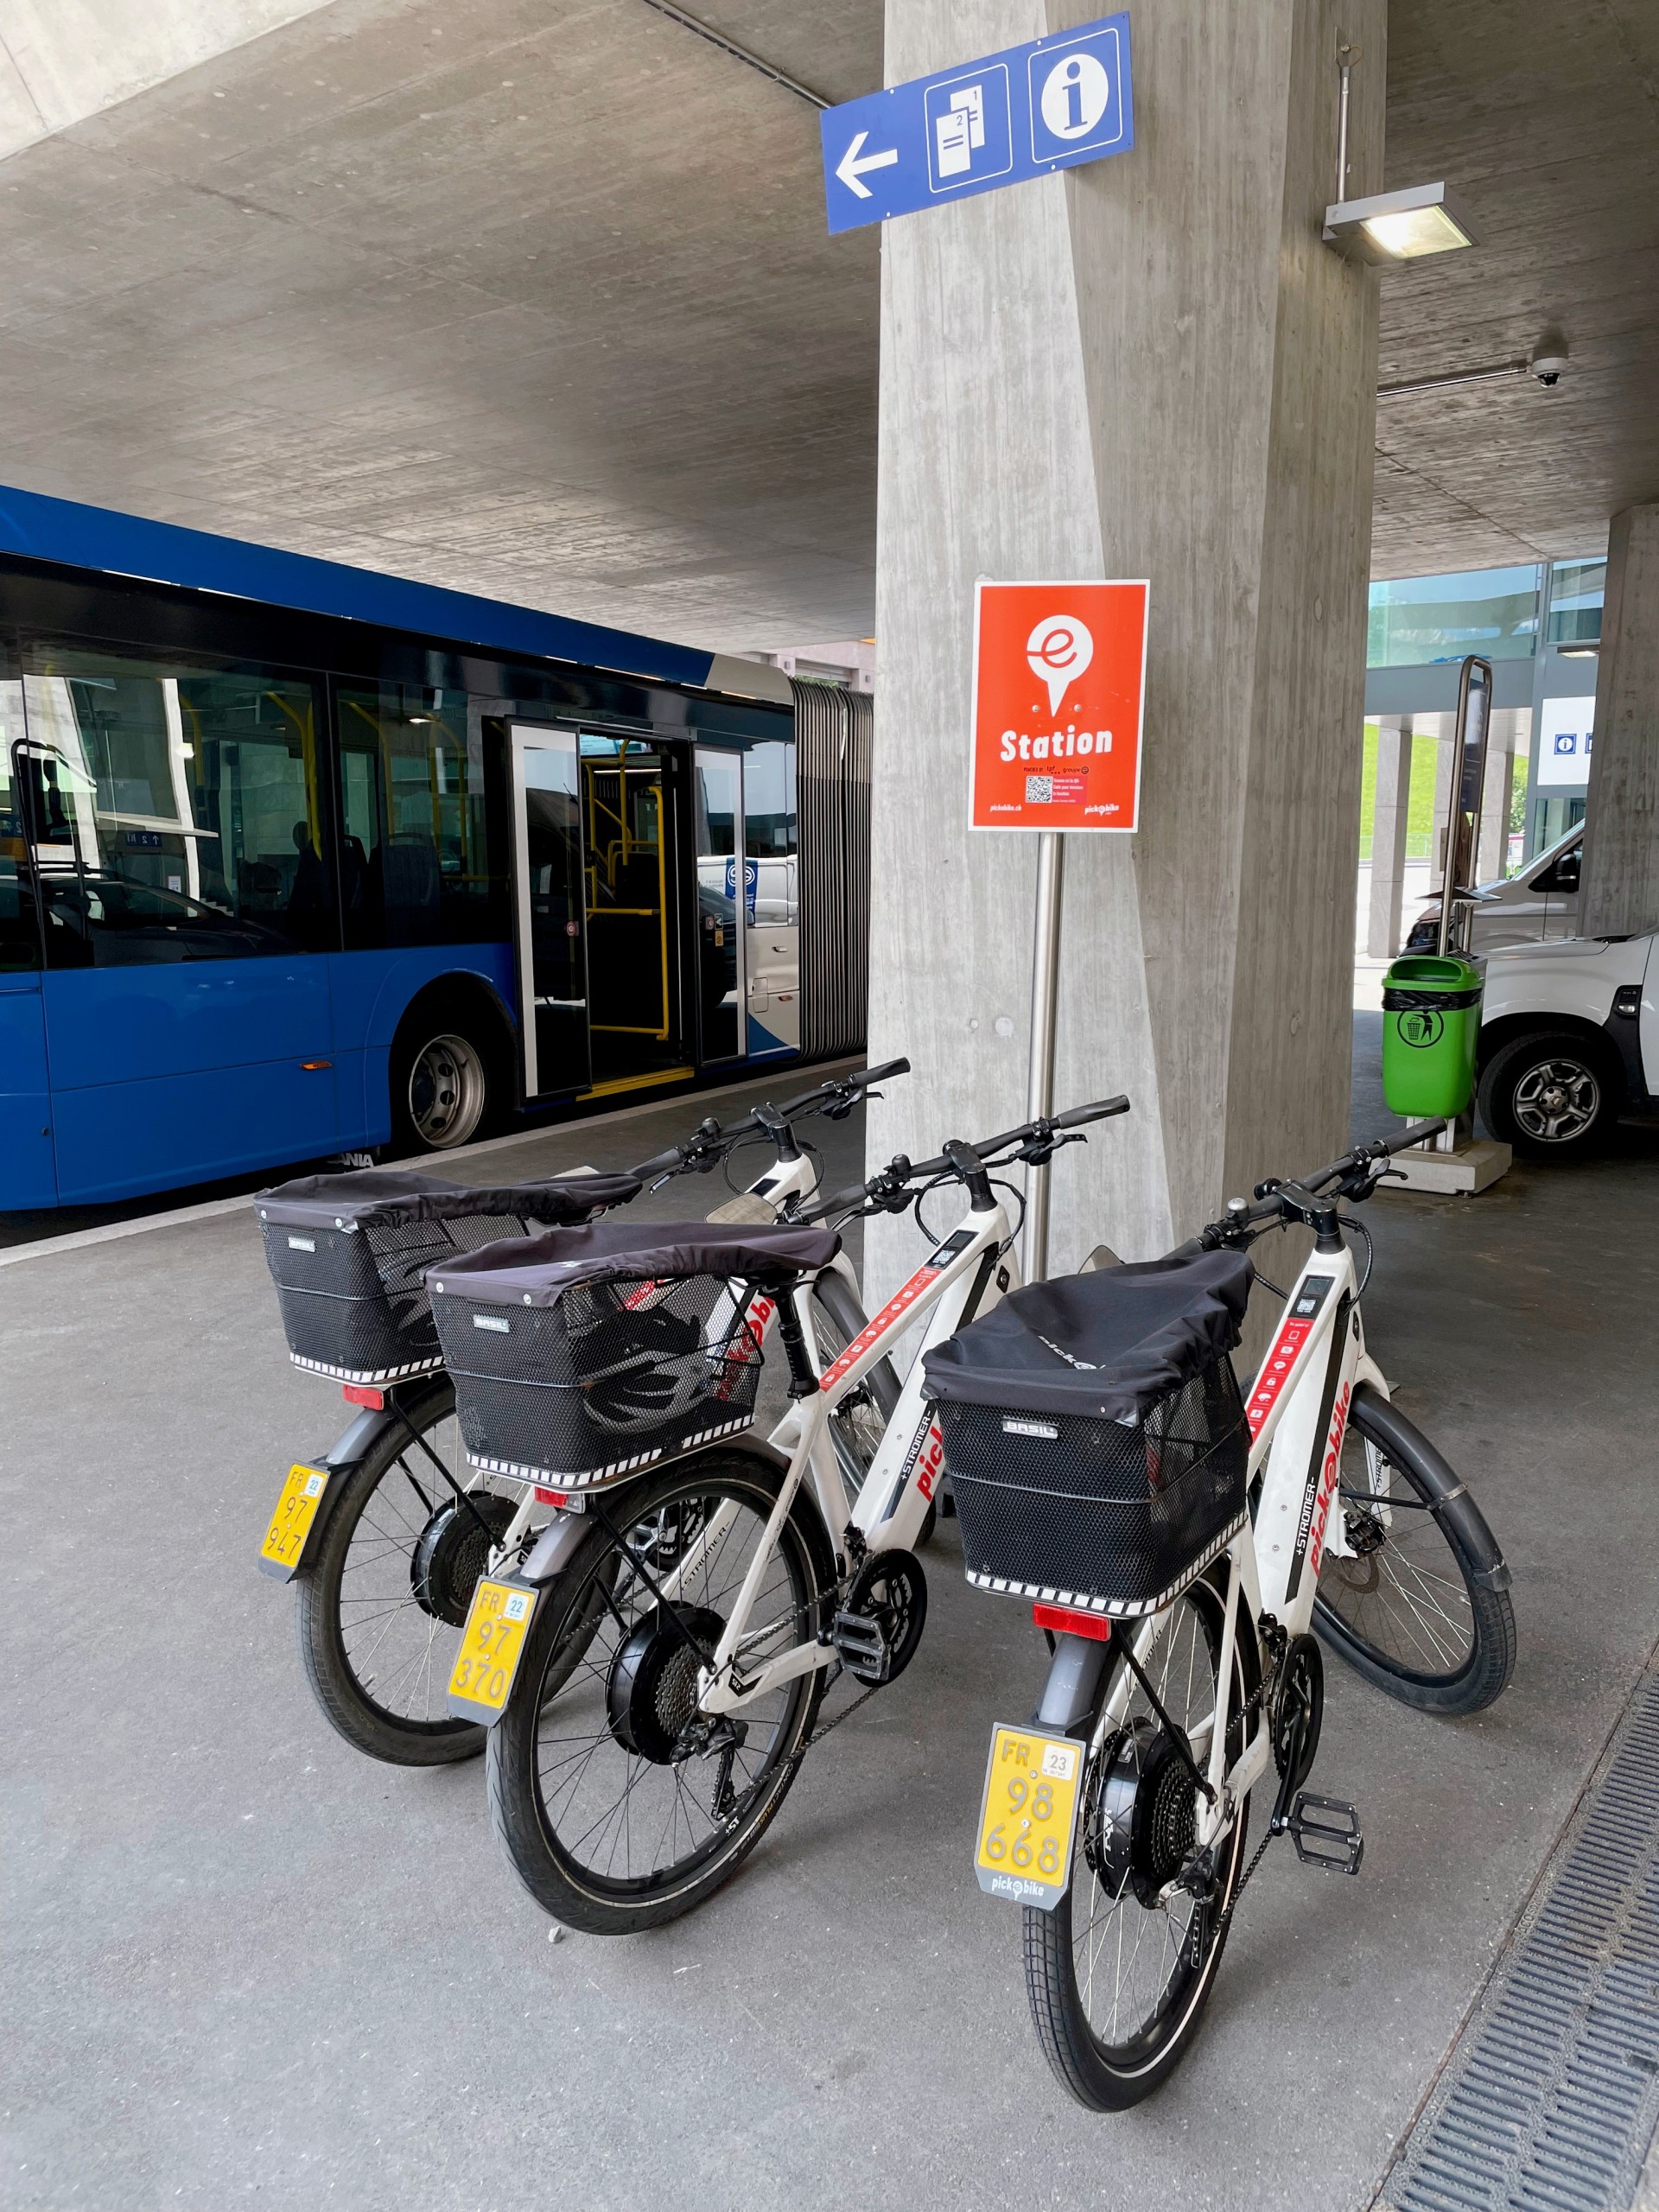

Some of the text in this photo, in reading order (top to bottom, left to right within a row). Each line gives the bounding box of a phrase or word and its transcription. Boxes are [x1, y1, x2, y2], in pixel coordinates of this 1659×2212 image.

[956, 114, 963, 126] 2
[1000, 724, 1113, 762] Station
[475, 1318, 507, 1330] BASIL
[1007, 1421, 1055, 1436] BASIL
[289, 1471, 304, 1489] FR
[309, 1479, 320, 1491] 22
[284, 1497, 308, 1523] 97
[269, 1527, 302, 1560] 947
[479, 1590, 523, 1613] FR 22
[477, 1620, 512, 1656] 97
[455, 1658, 506, 1700] 370
[1001, 1738, 1067, 1771] FR 23
[1007, 1777, 1054, 1821] 98
[986, 1823, 1059, 1874] 668
